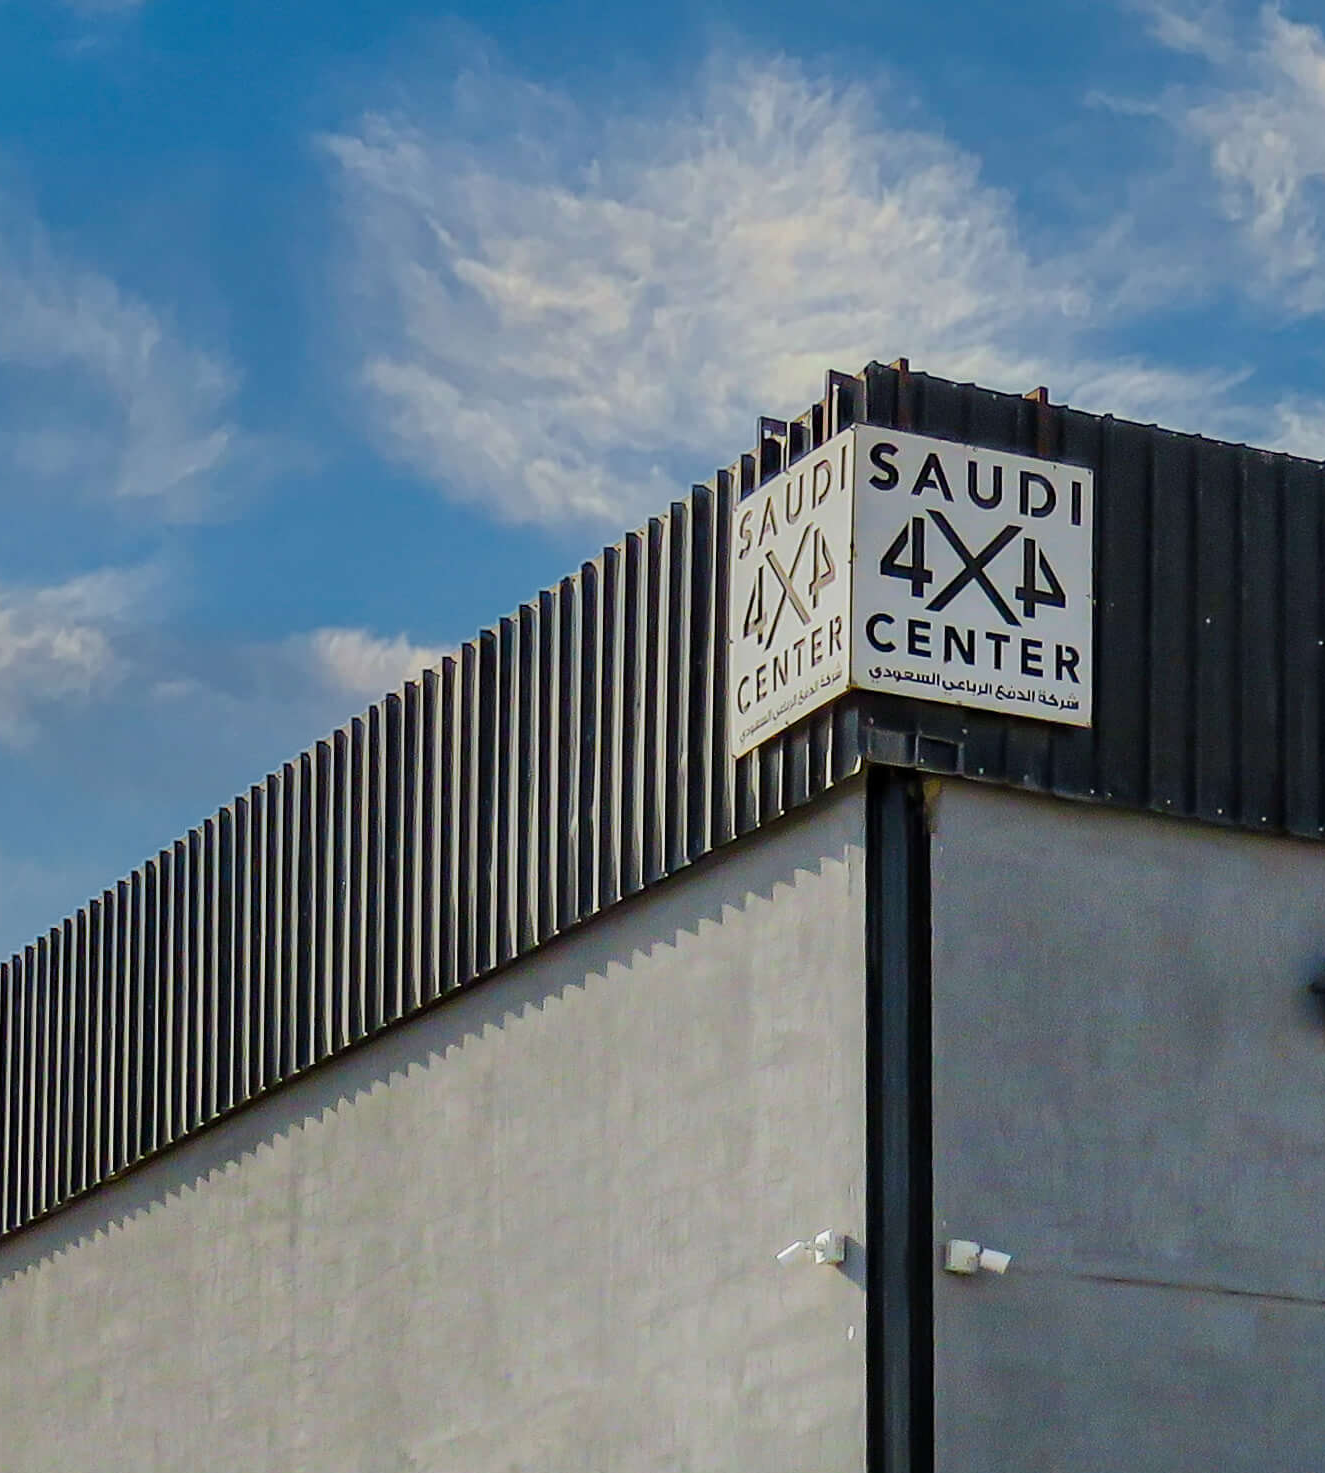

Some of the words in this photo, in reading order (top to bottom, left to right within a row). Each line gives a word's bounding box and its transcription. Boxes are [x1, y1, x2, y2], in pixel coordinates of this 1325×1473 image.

[739, 445, 847, 559] SAUDI
[869, 442, 1082, 526] SAUDI
[737, 616, 844, 714] CENTER
[865, 613, 1081, 684] CENTER
[868, 665, 940, 687] السعودي
[1038, 688, 1079, 711] شركة
